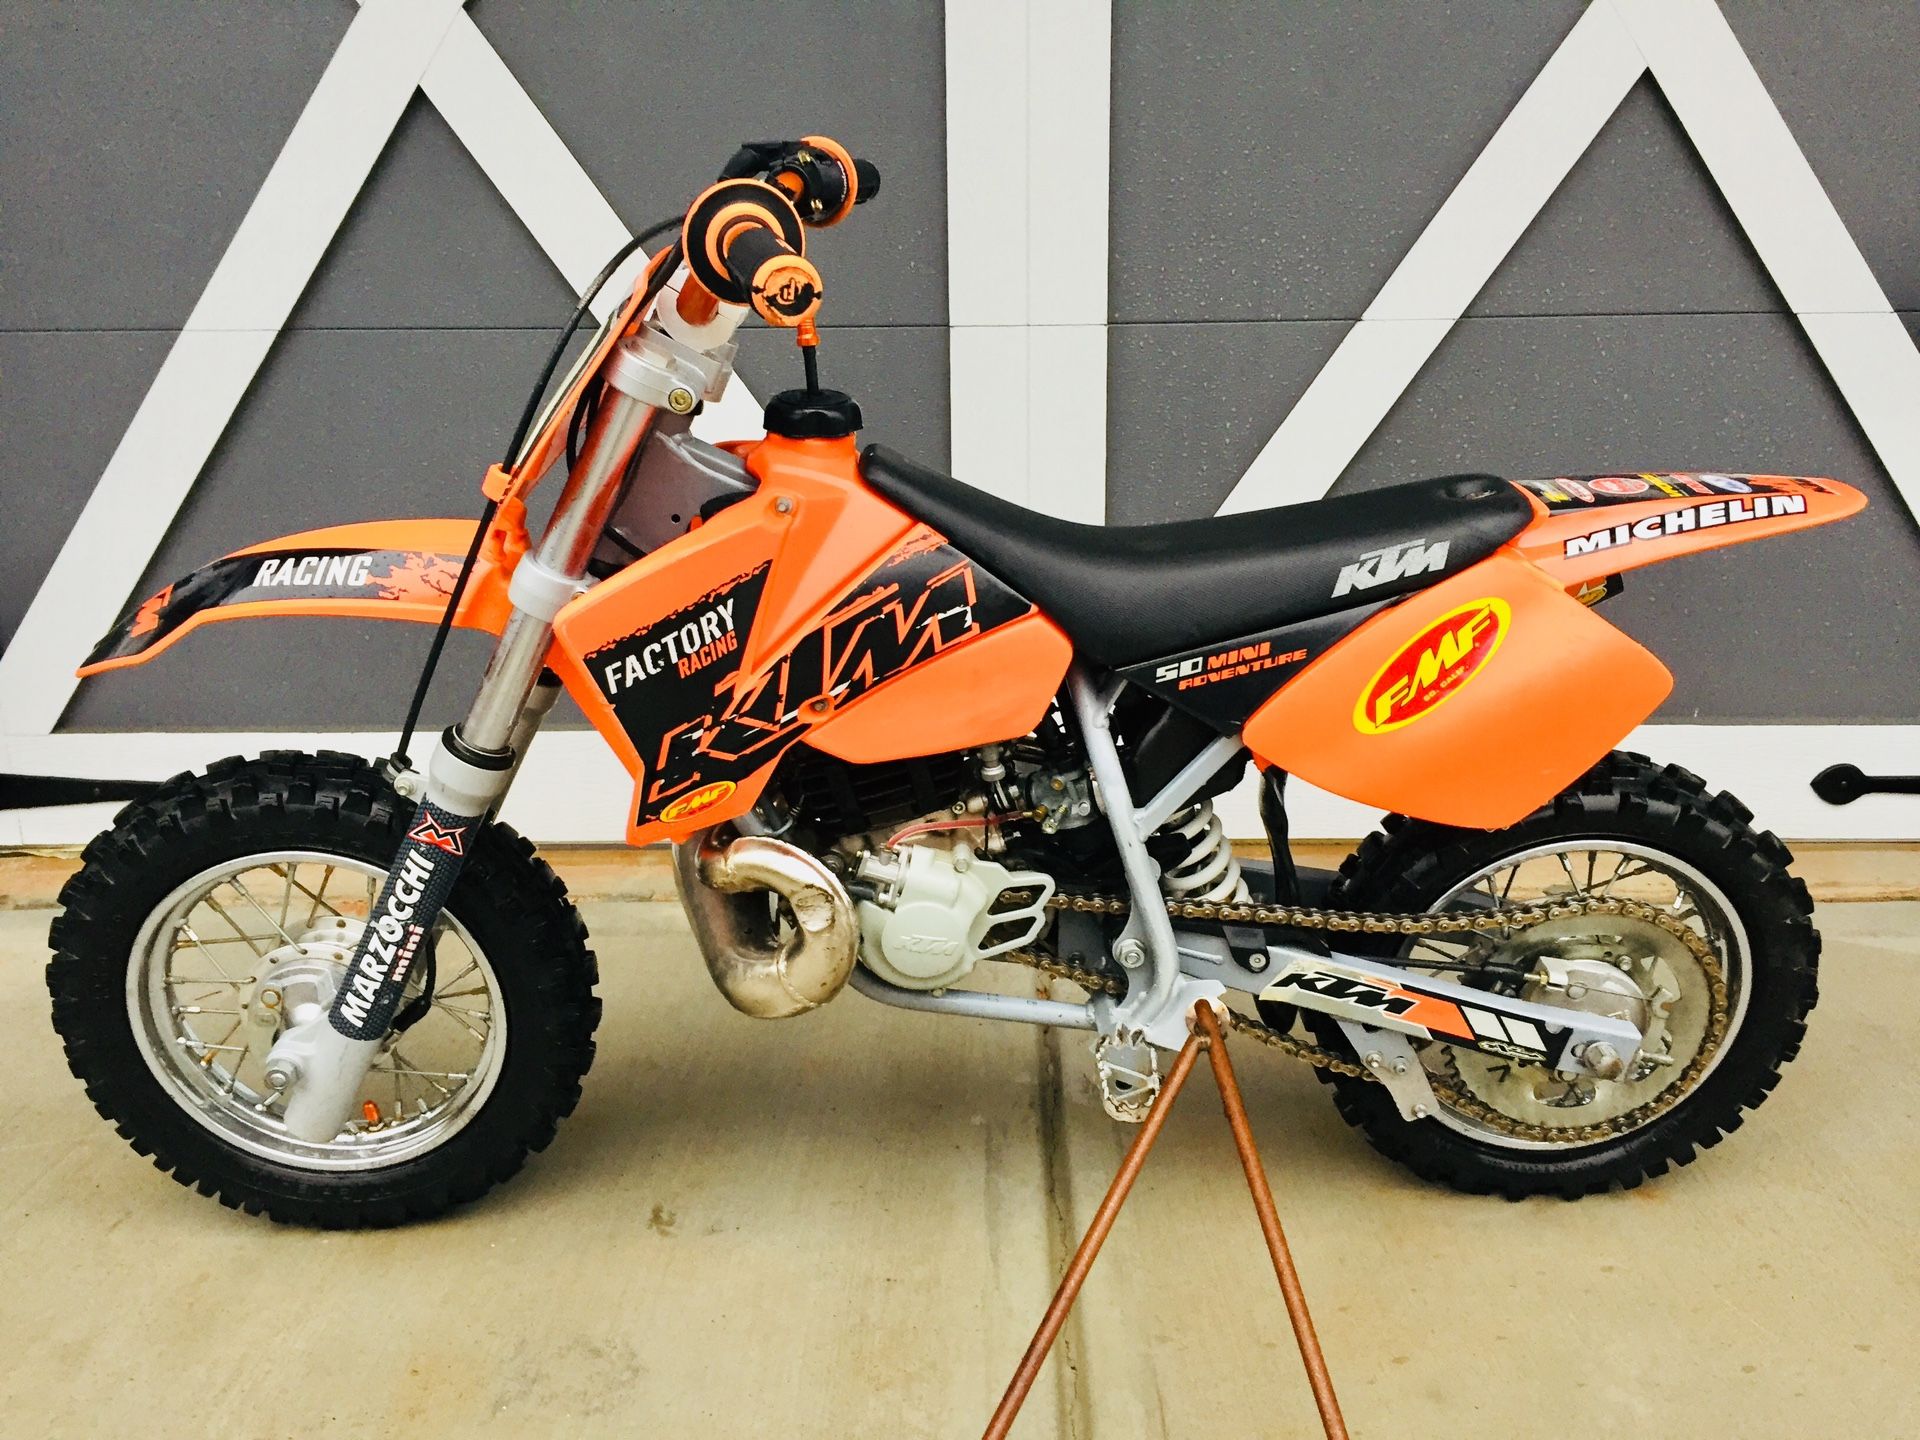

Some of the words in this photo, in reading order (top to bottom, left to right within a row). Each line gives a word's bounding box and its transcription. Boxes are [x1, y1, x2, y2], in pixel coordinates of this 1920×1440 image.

[1565, 495, 1806, 558] MICHELIN
[252, 554, 374, 588] RACING
[1330, 538, 1450, 599] KTM
[604, 598, 735, 695] FACTORY
[678, 630, 738, 680] RACING
[1155, 656, 1204, 684] 50
[1207, 641, 1272, 670] MINI
[1178, 648, 1308, 691] ADVENTURE
[1375, 603, 1491, 729] FMF
[666, 782, 729, 820] FMF
[339, 848, 435, 1029] MARZOCCHI
[391, 923, 425, 983] mini
[893, 933, 960, 957] KTM
[1271, 970, 1417, 1015] KTM
